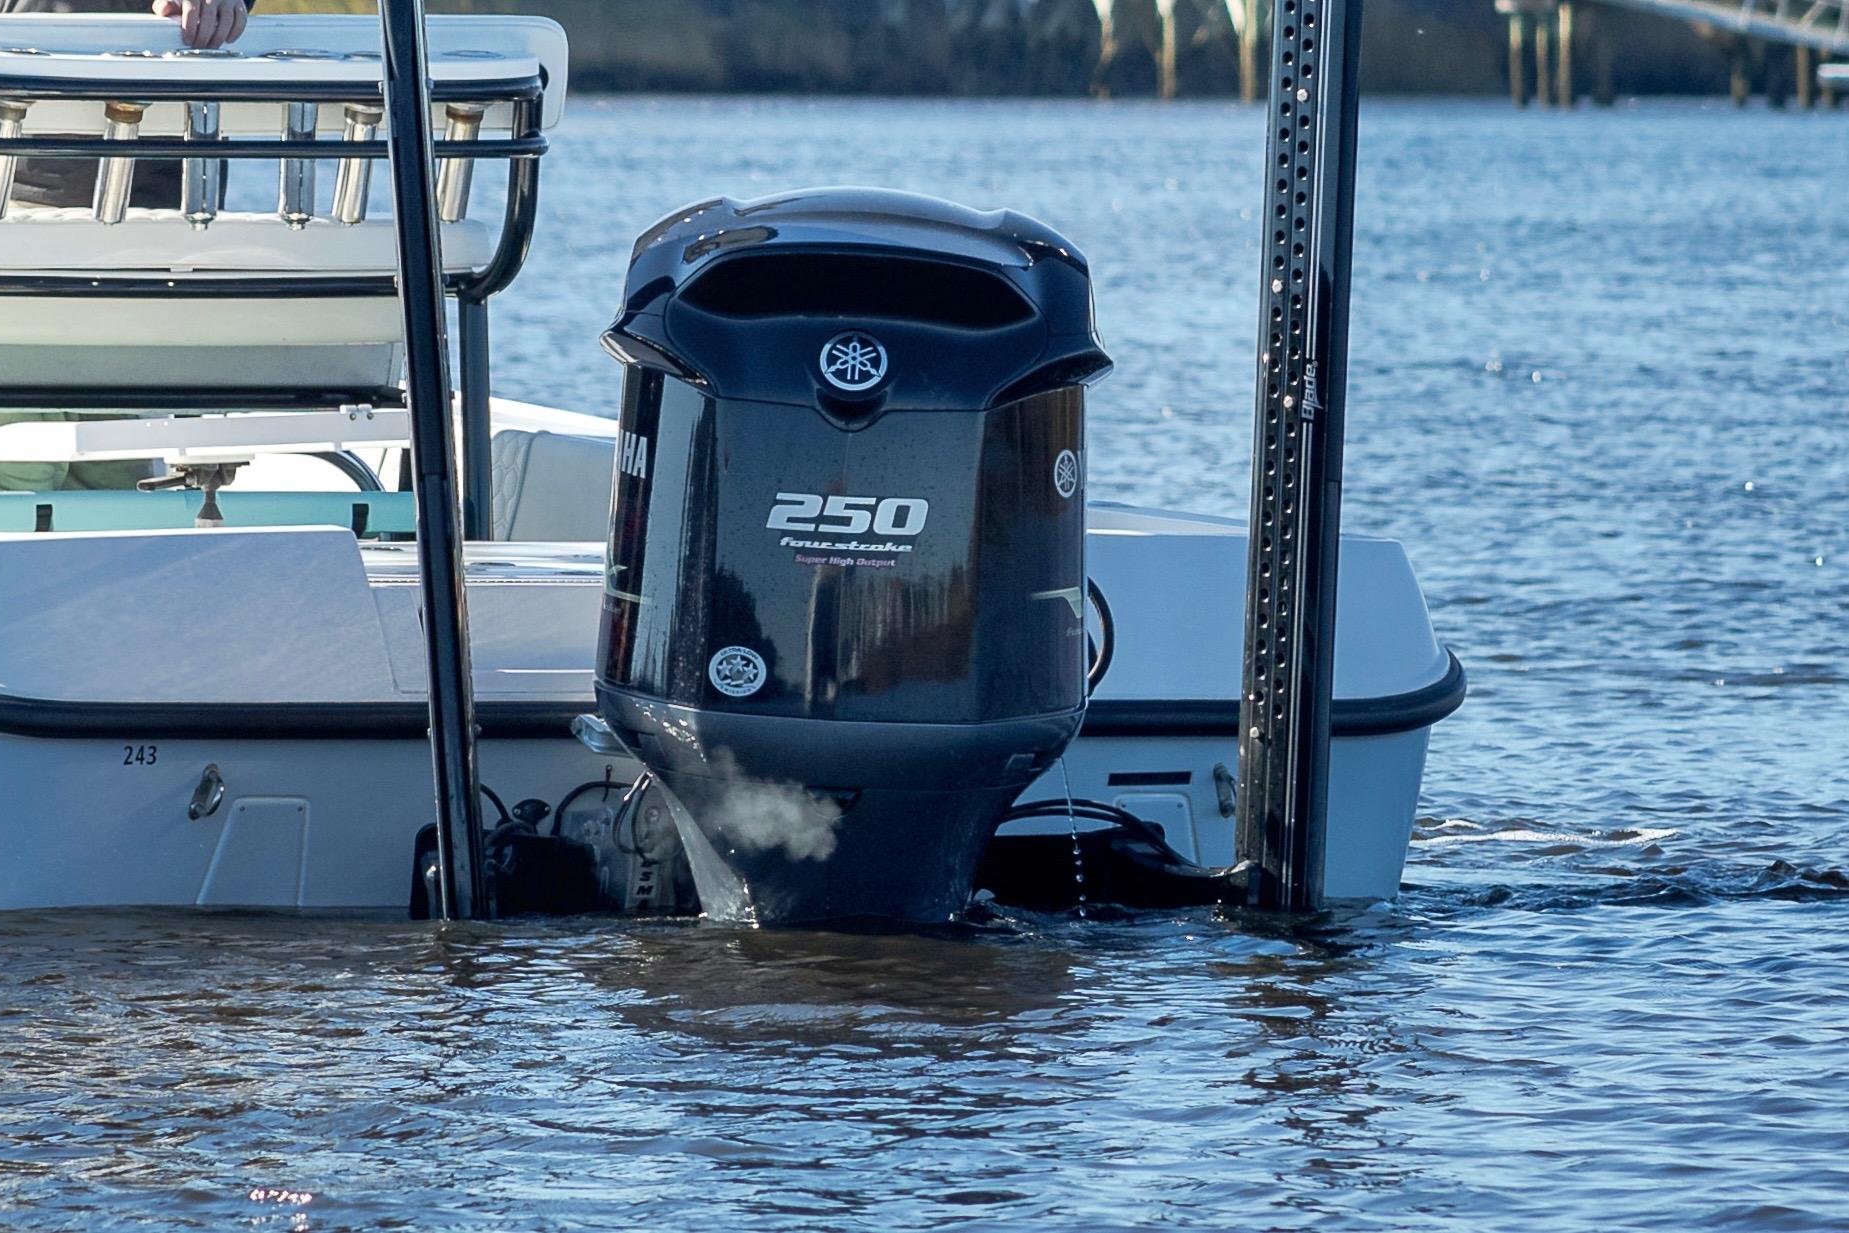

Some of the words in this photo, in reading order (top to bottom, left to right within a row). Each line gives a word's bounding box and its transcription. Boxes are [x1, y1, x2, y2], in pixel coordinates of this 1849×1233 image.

[1301, 363, 1320, 420] Blade
[766, 492, 929, 536] 250
[795, 554, 827, 565] Super
[829, 556, 854, 567] High
[856, 557, 896, 568] Output
[123, 745, 157, 766] 243
